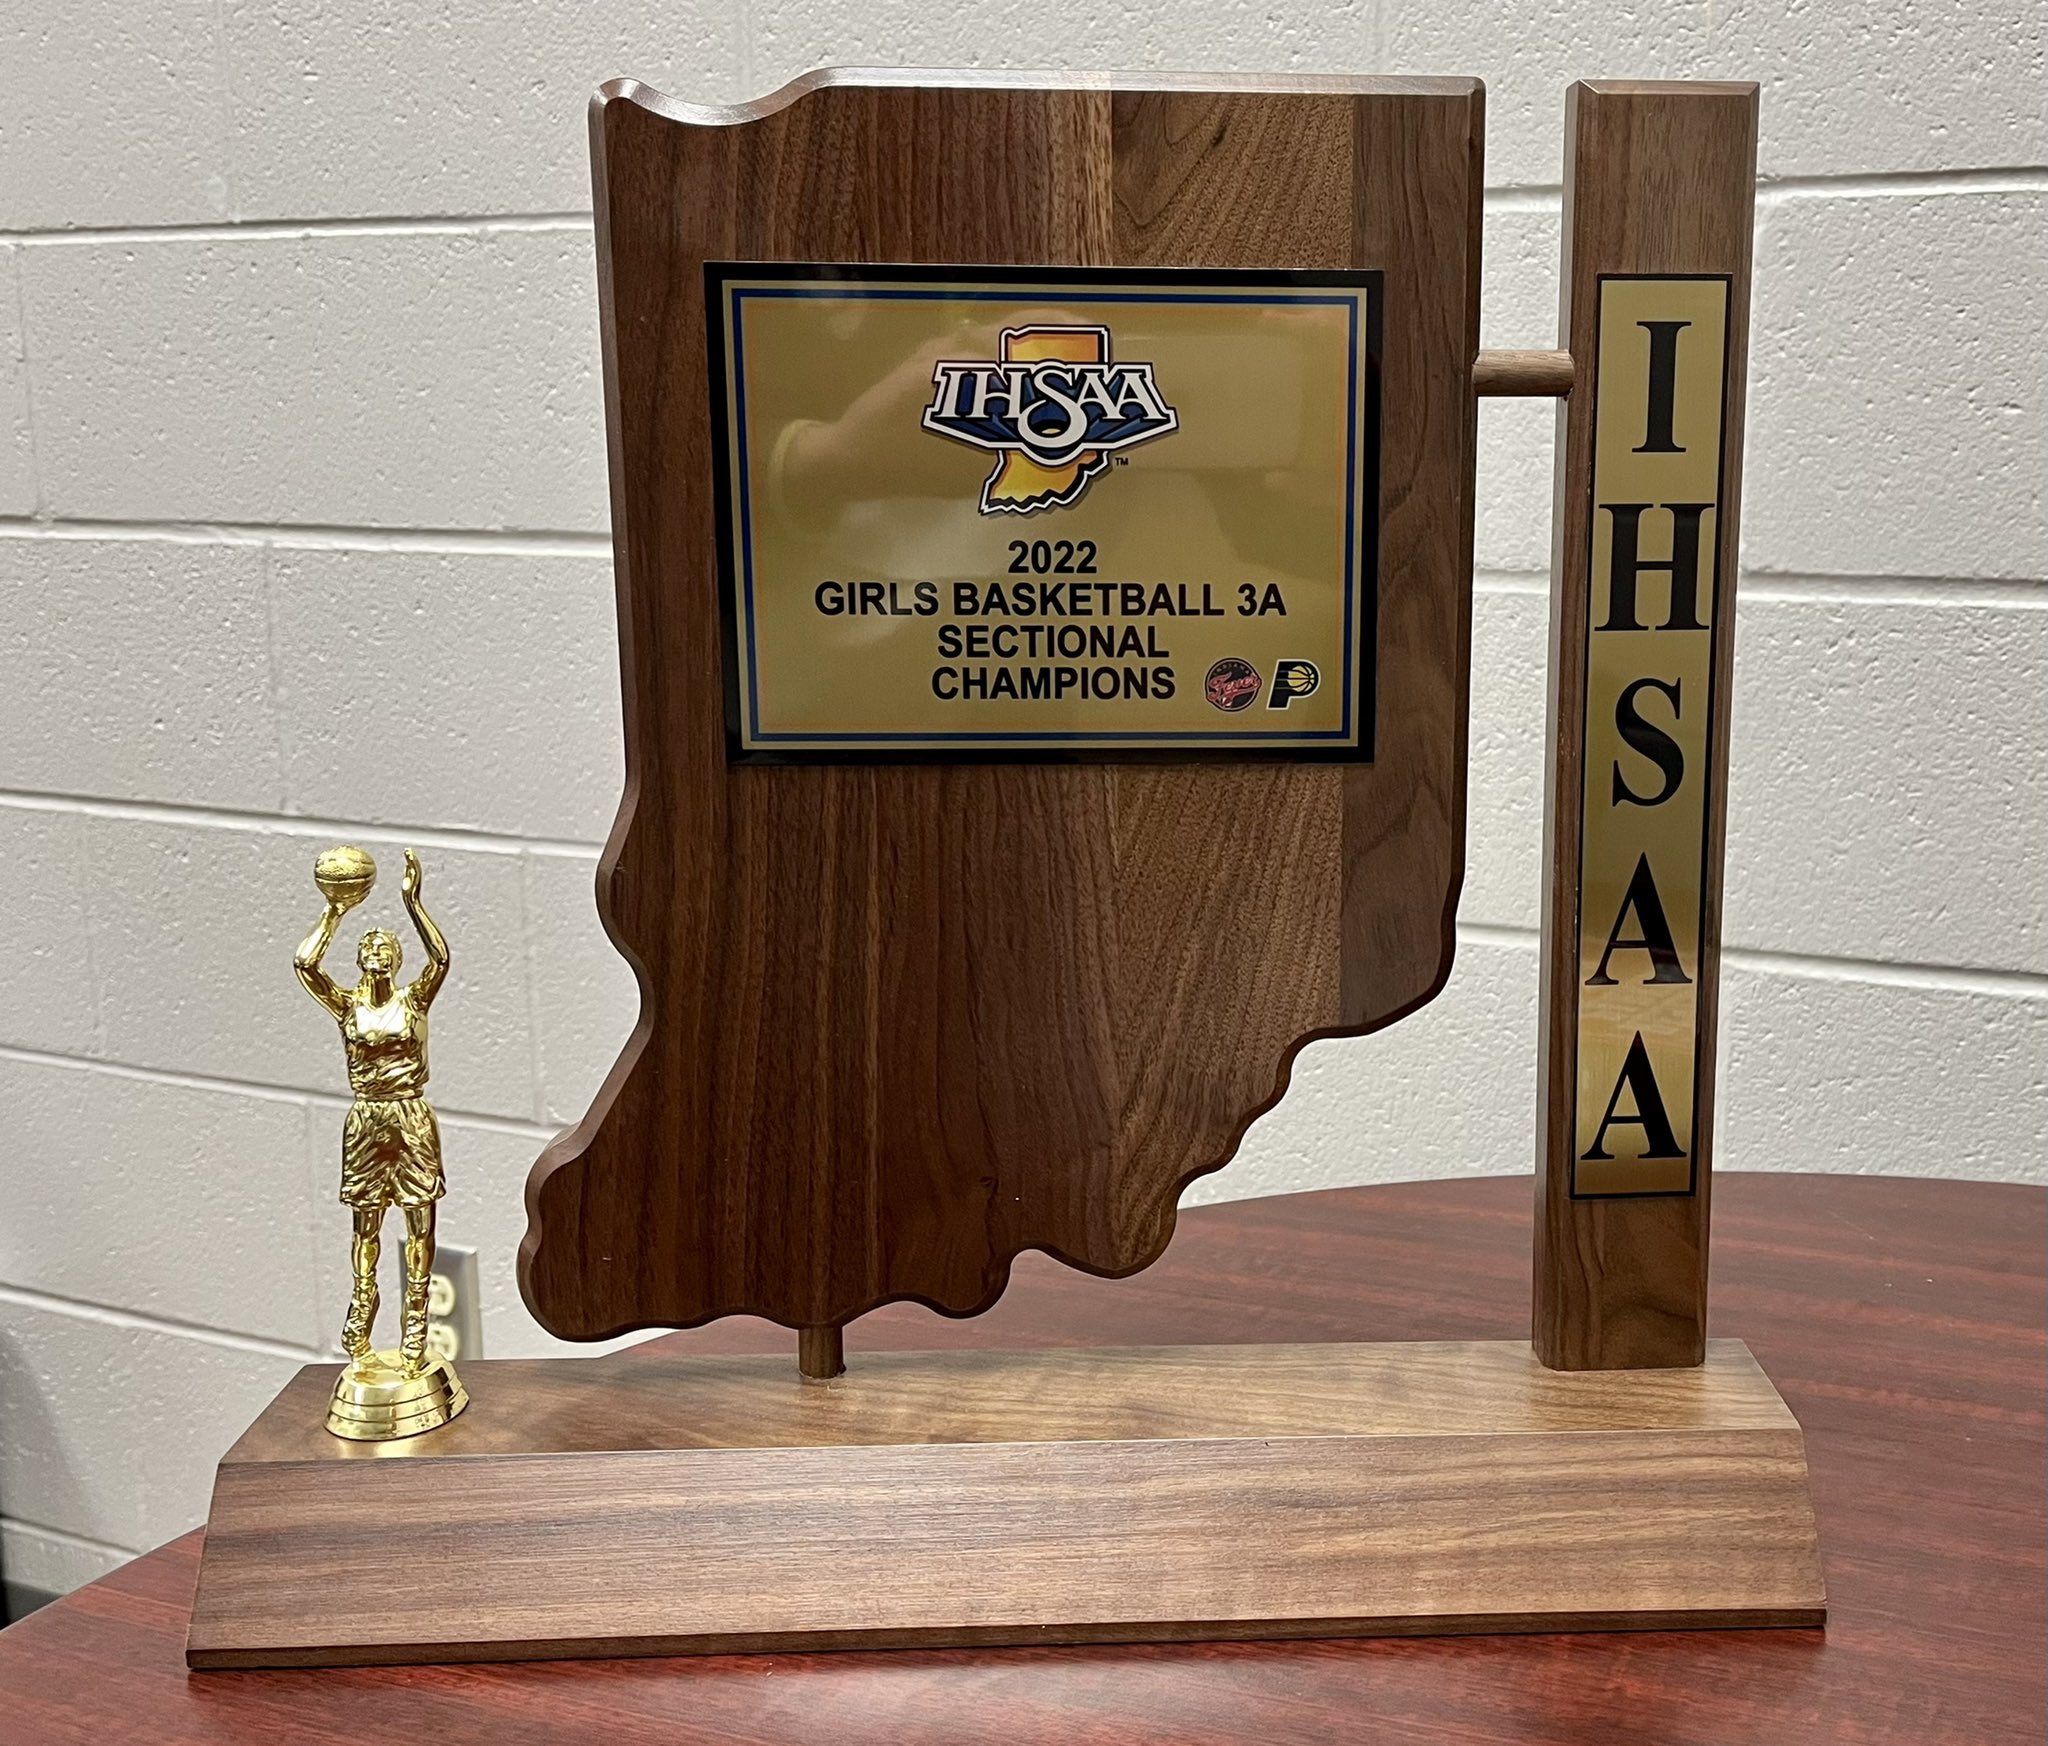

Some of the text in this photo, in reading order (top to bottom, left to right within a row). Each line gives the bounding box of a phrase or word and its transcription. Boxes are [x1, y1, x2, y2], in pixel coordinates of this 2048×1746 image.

[937, 369, 1167, 448] IHSAA
[1115, 457, 1129, 467] TM
[1007, 539, 1098, 575] 2022
[814, 580, 1288, 617] GIRLS BASKETBALL 3A
[936, 624, 1171, 659] SECTIONAL
[930, 665, 1176, 701] CHAMPIONS
[1580, 320, 1715, 1161] IHSAA
